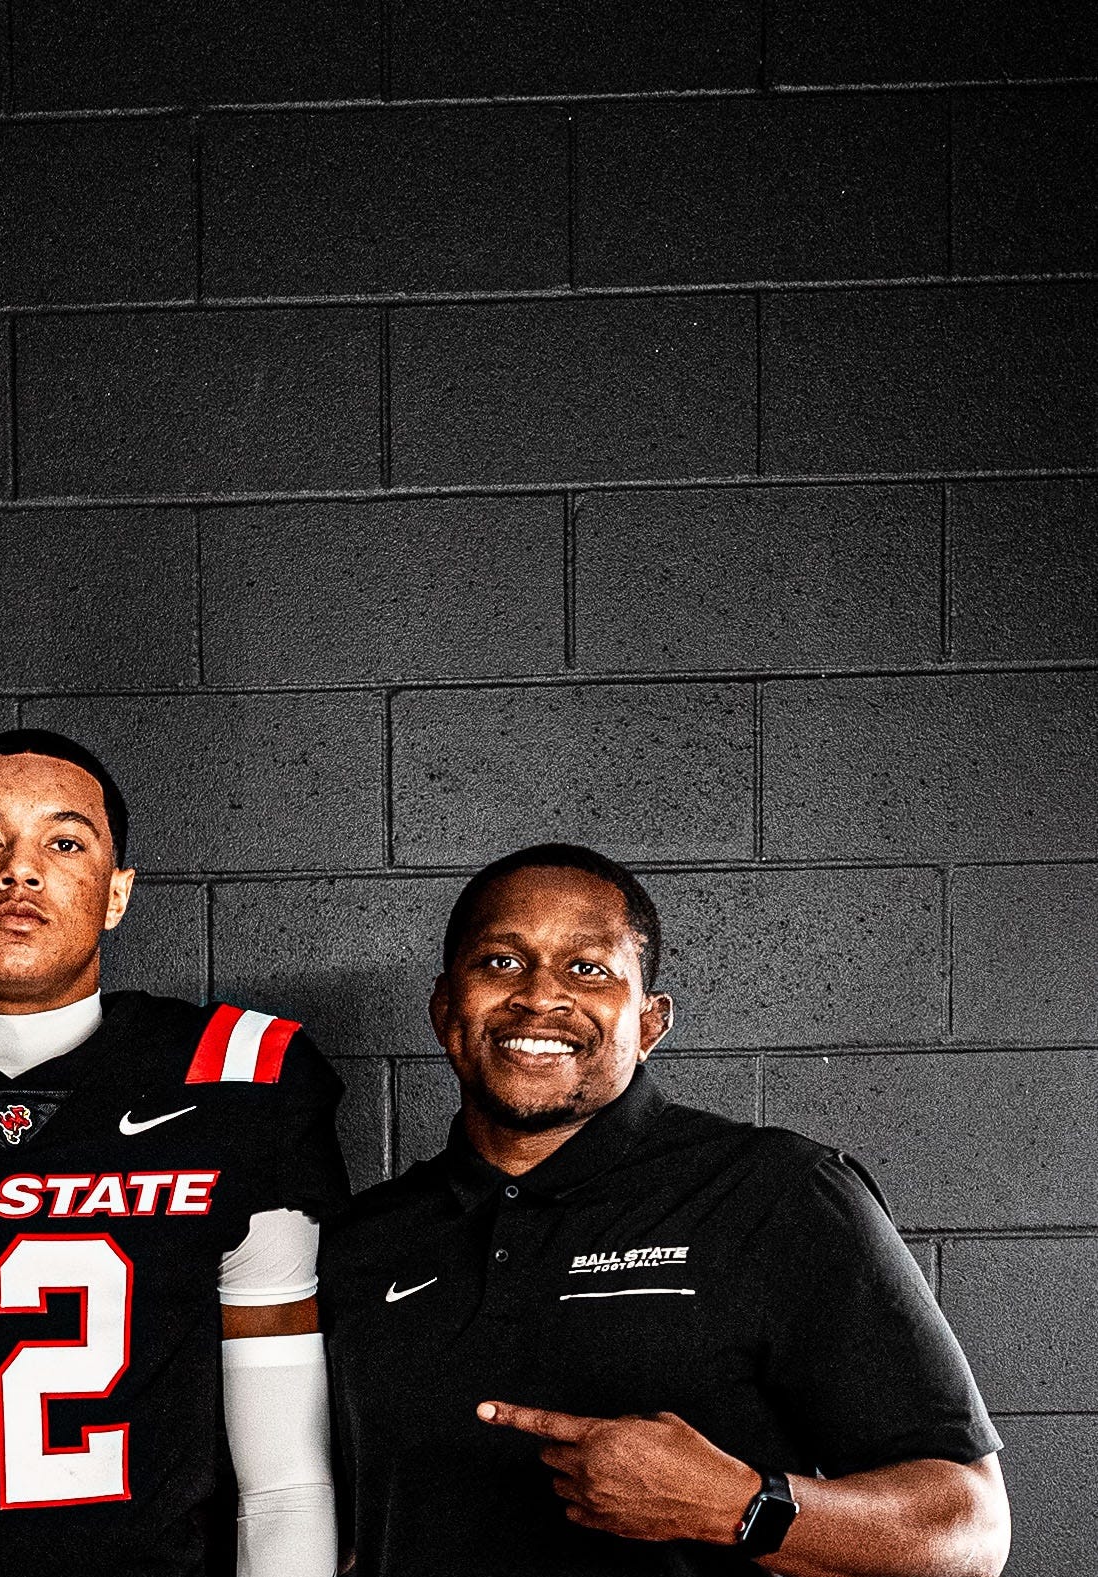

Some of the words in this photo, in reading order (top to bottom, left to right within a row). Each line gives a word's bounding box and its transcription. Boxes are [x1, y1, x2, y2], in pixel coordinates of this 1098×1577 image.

[571, 1251, 621, 1268] BALL
[623, 1246, 689, 1260] STATE
[592, 1259, 659, 1273] FOOTBALL
